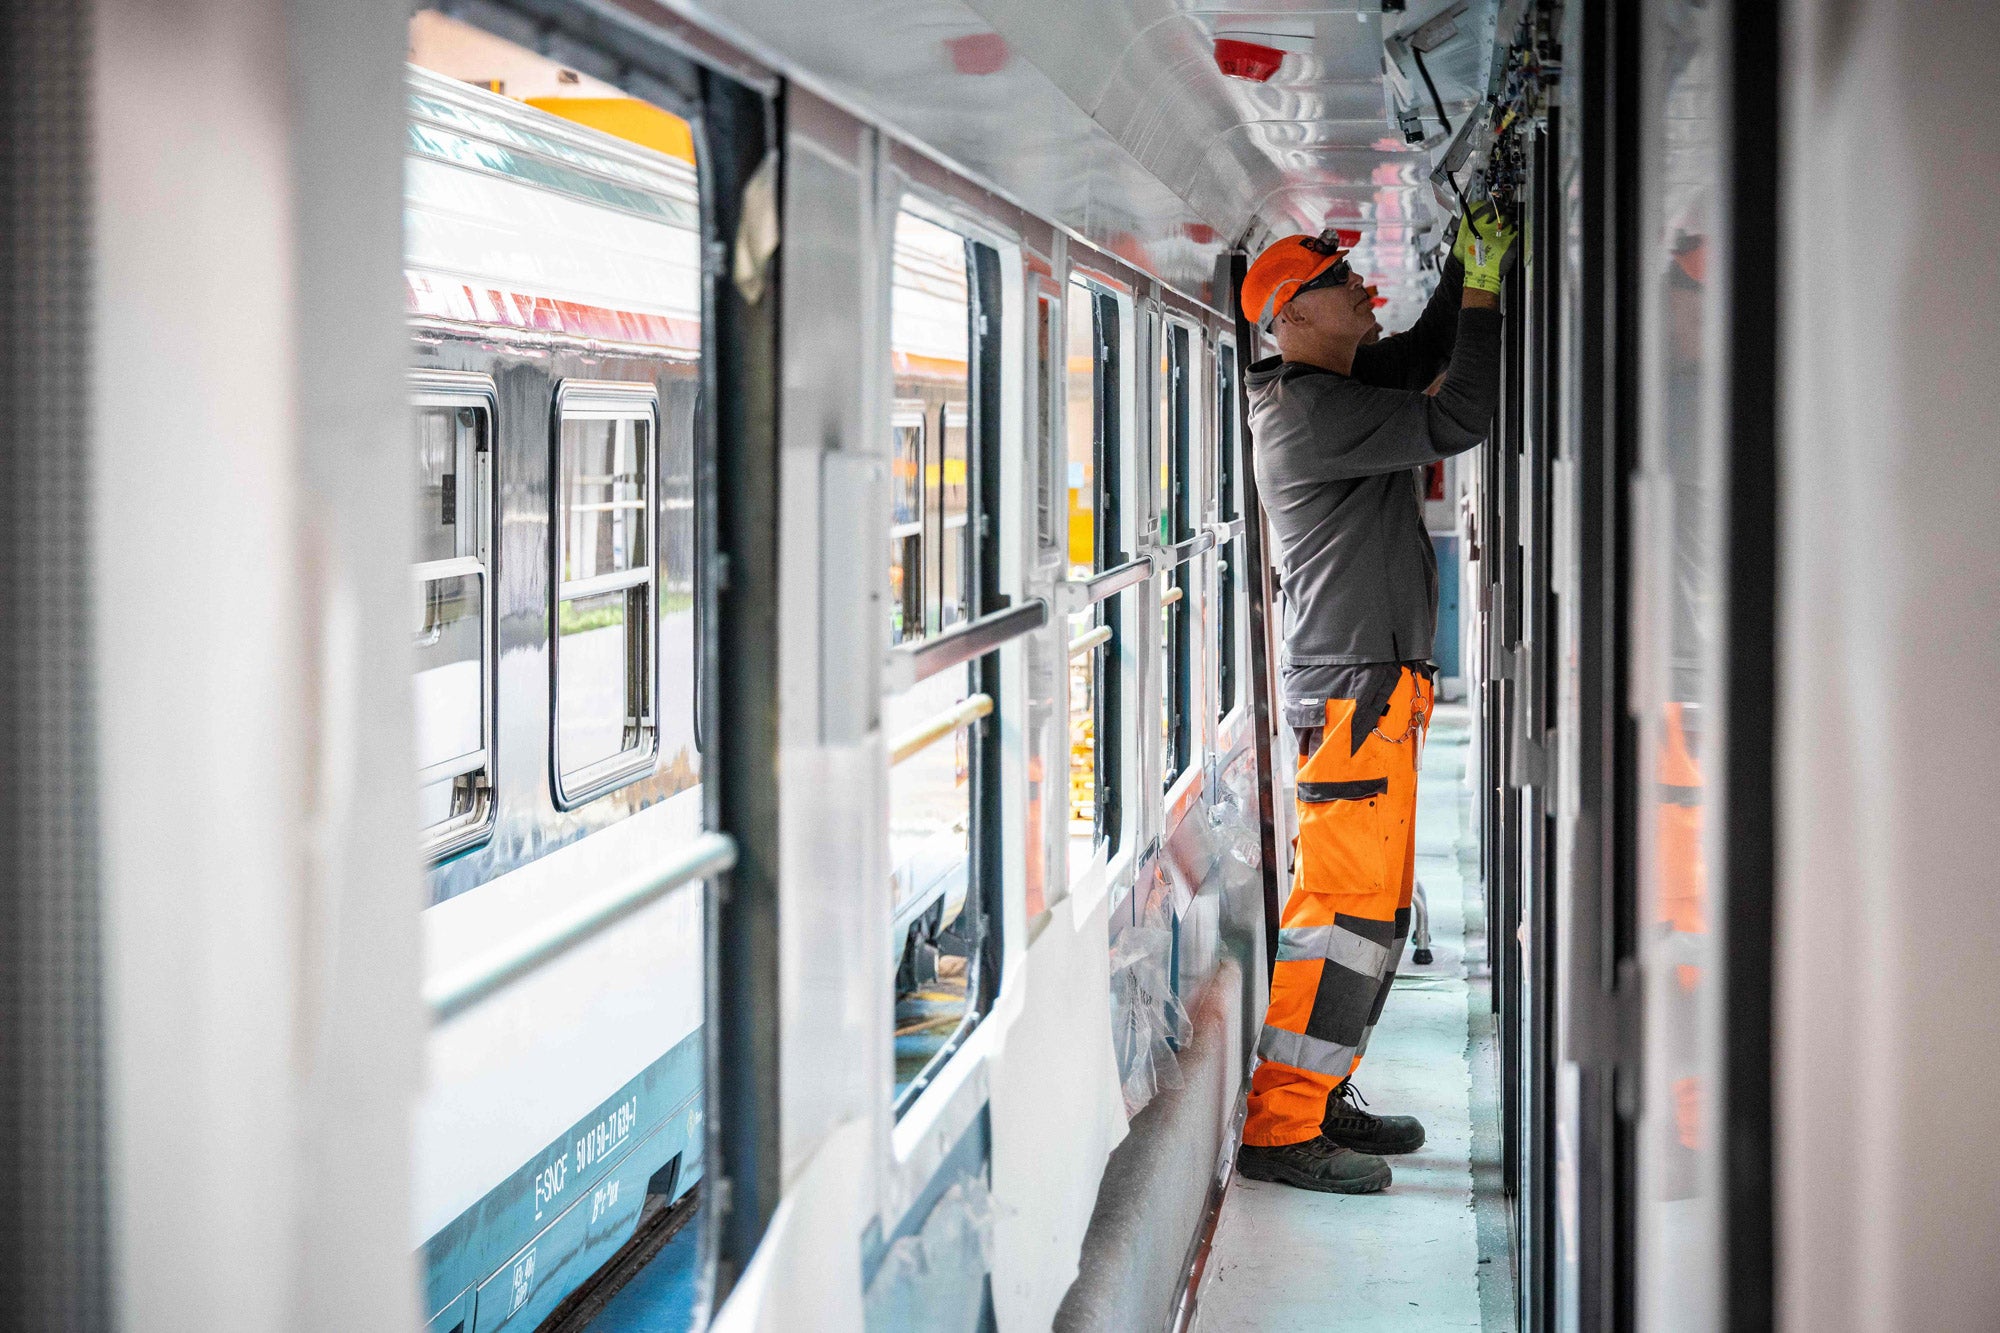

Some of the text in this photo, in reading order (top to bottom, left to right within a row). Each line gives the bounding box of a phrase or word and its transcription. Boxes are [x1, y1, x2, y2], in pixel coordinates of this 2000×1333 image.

[535, 1153, 568, 1211] F-SNCF
[577, 1137, 586, 1173] 50
[587, 1129, 596, 1165] 87
